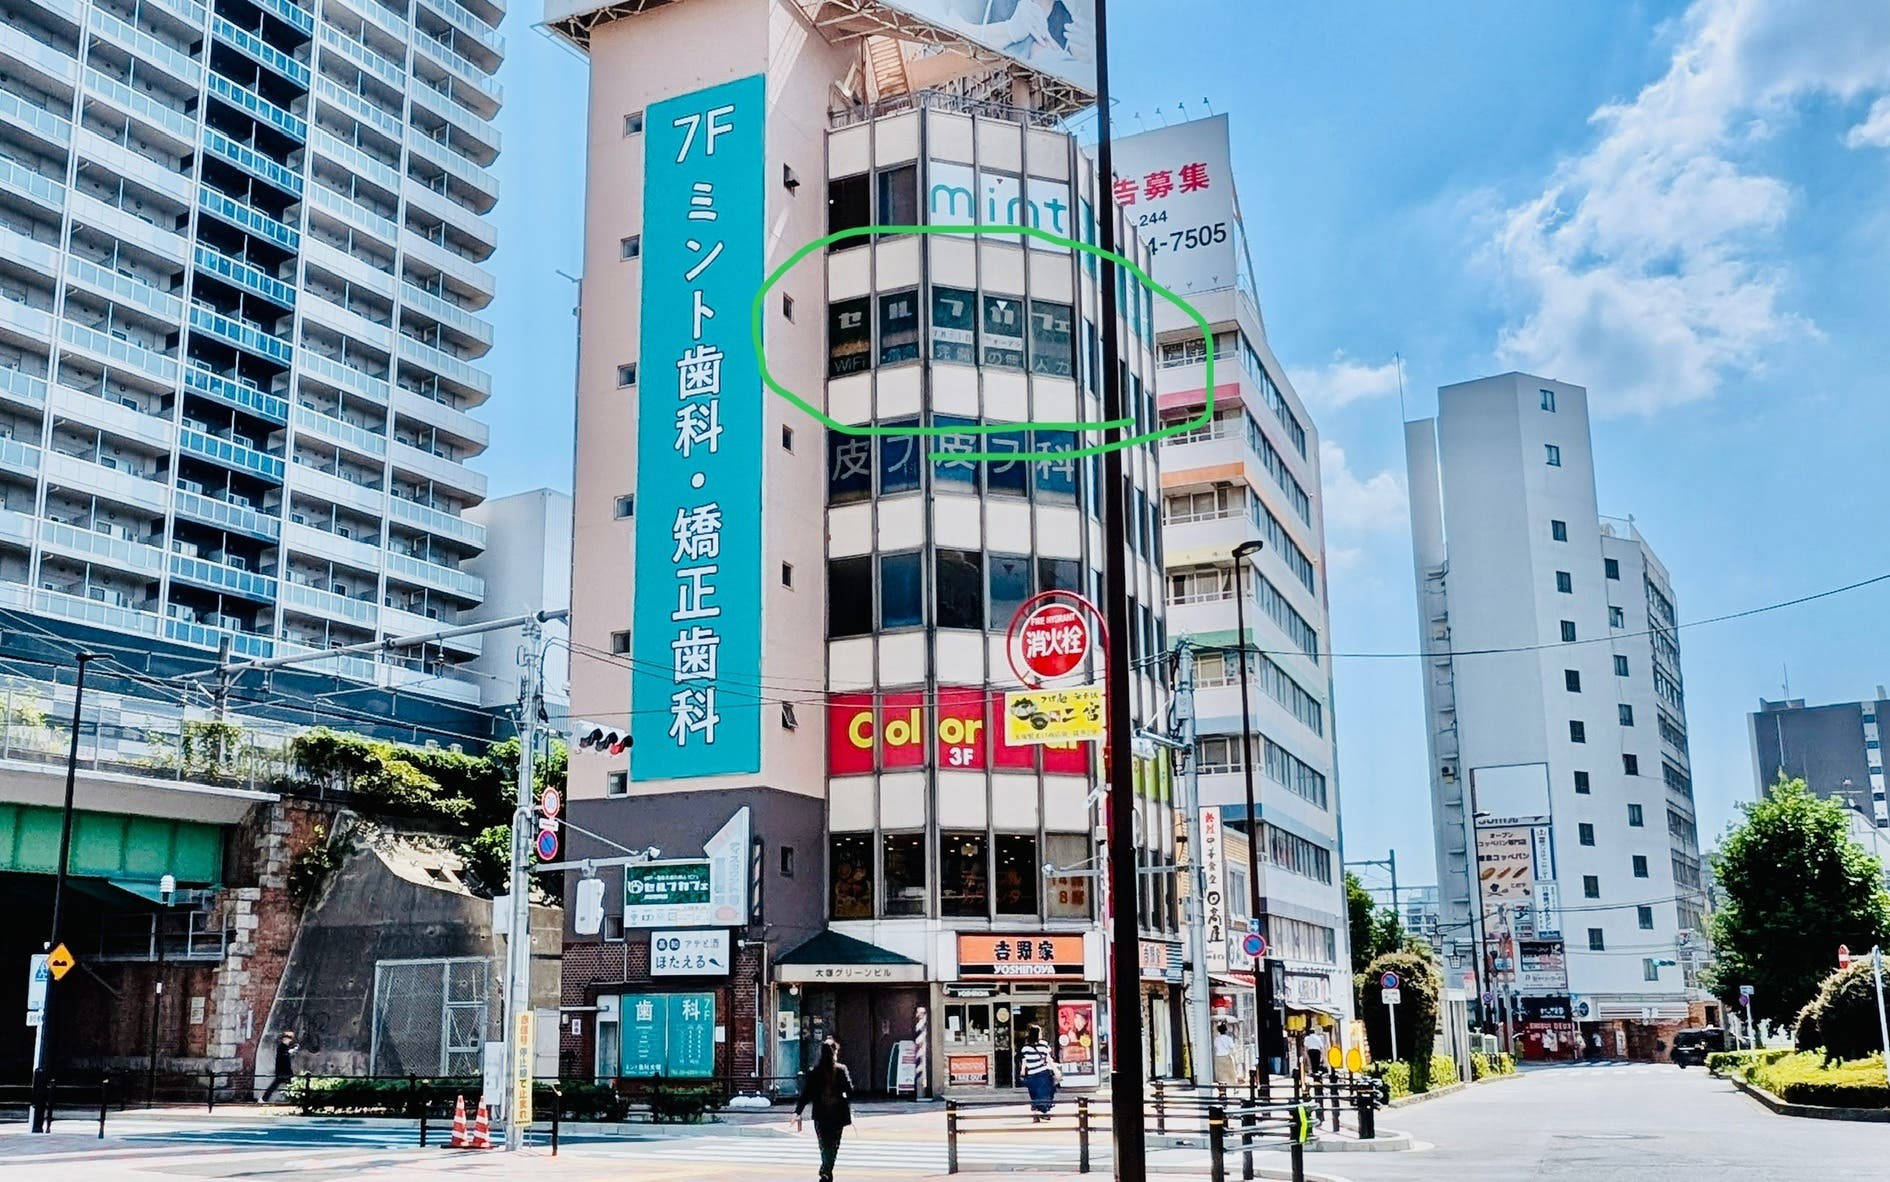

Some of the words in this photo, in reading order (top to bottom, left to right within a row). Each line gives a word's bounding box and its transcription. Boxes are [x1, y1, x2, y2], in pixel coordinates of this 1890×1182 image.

[672, 104, 736, 165] 7F
[930, 184, 1068, 234] mint
[1139, 210, 1169, 228] 244
[668, 181, 725, 747] ミント歯科・矯正歯科
[1026, 625, 1084, 659] 消火栓
[848, 708, 983, 749] Color
[949, 747, 974, 766] 3F
[644, 881, 709, 893] セルフカフェ
[656, 955, 706, 969] ほたえる
[815, 968, 892, 978] 大塚グリーンビル
[635, 998, 654, 1022] 歯
[682, 998, 700, 1022] 科
